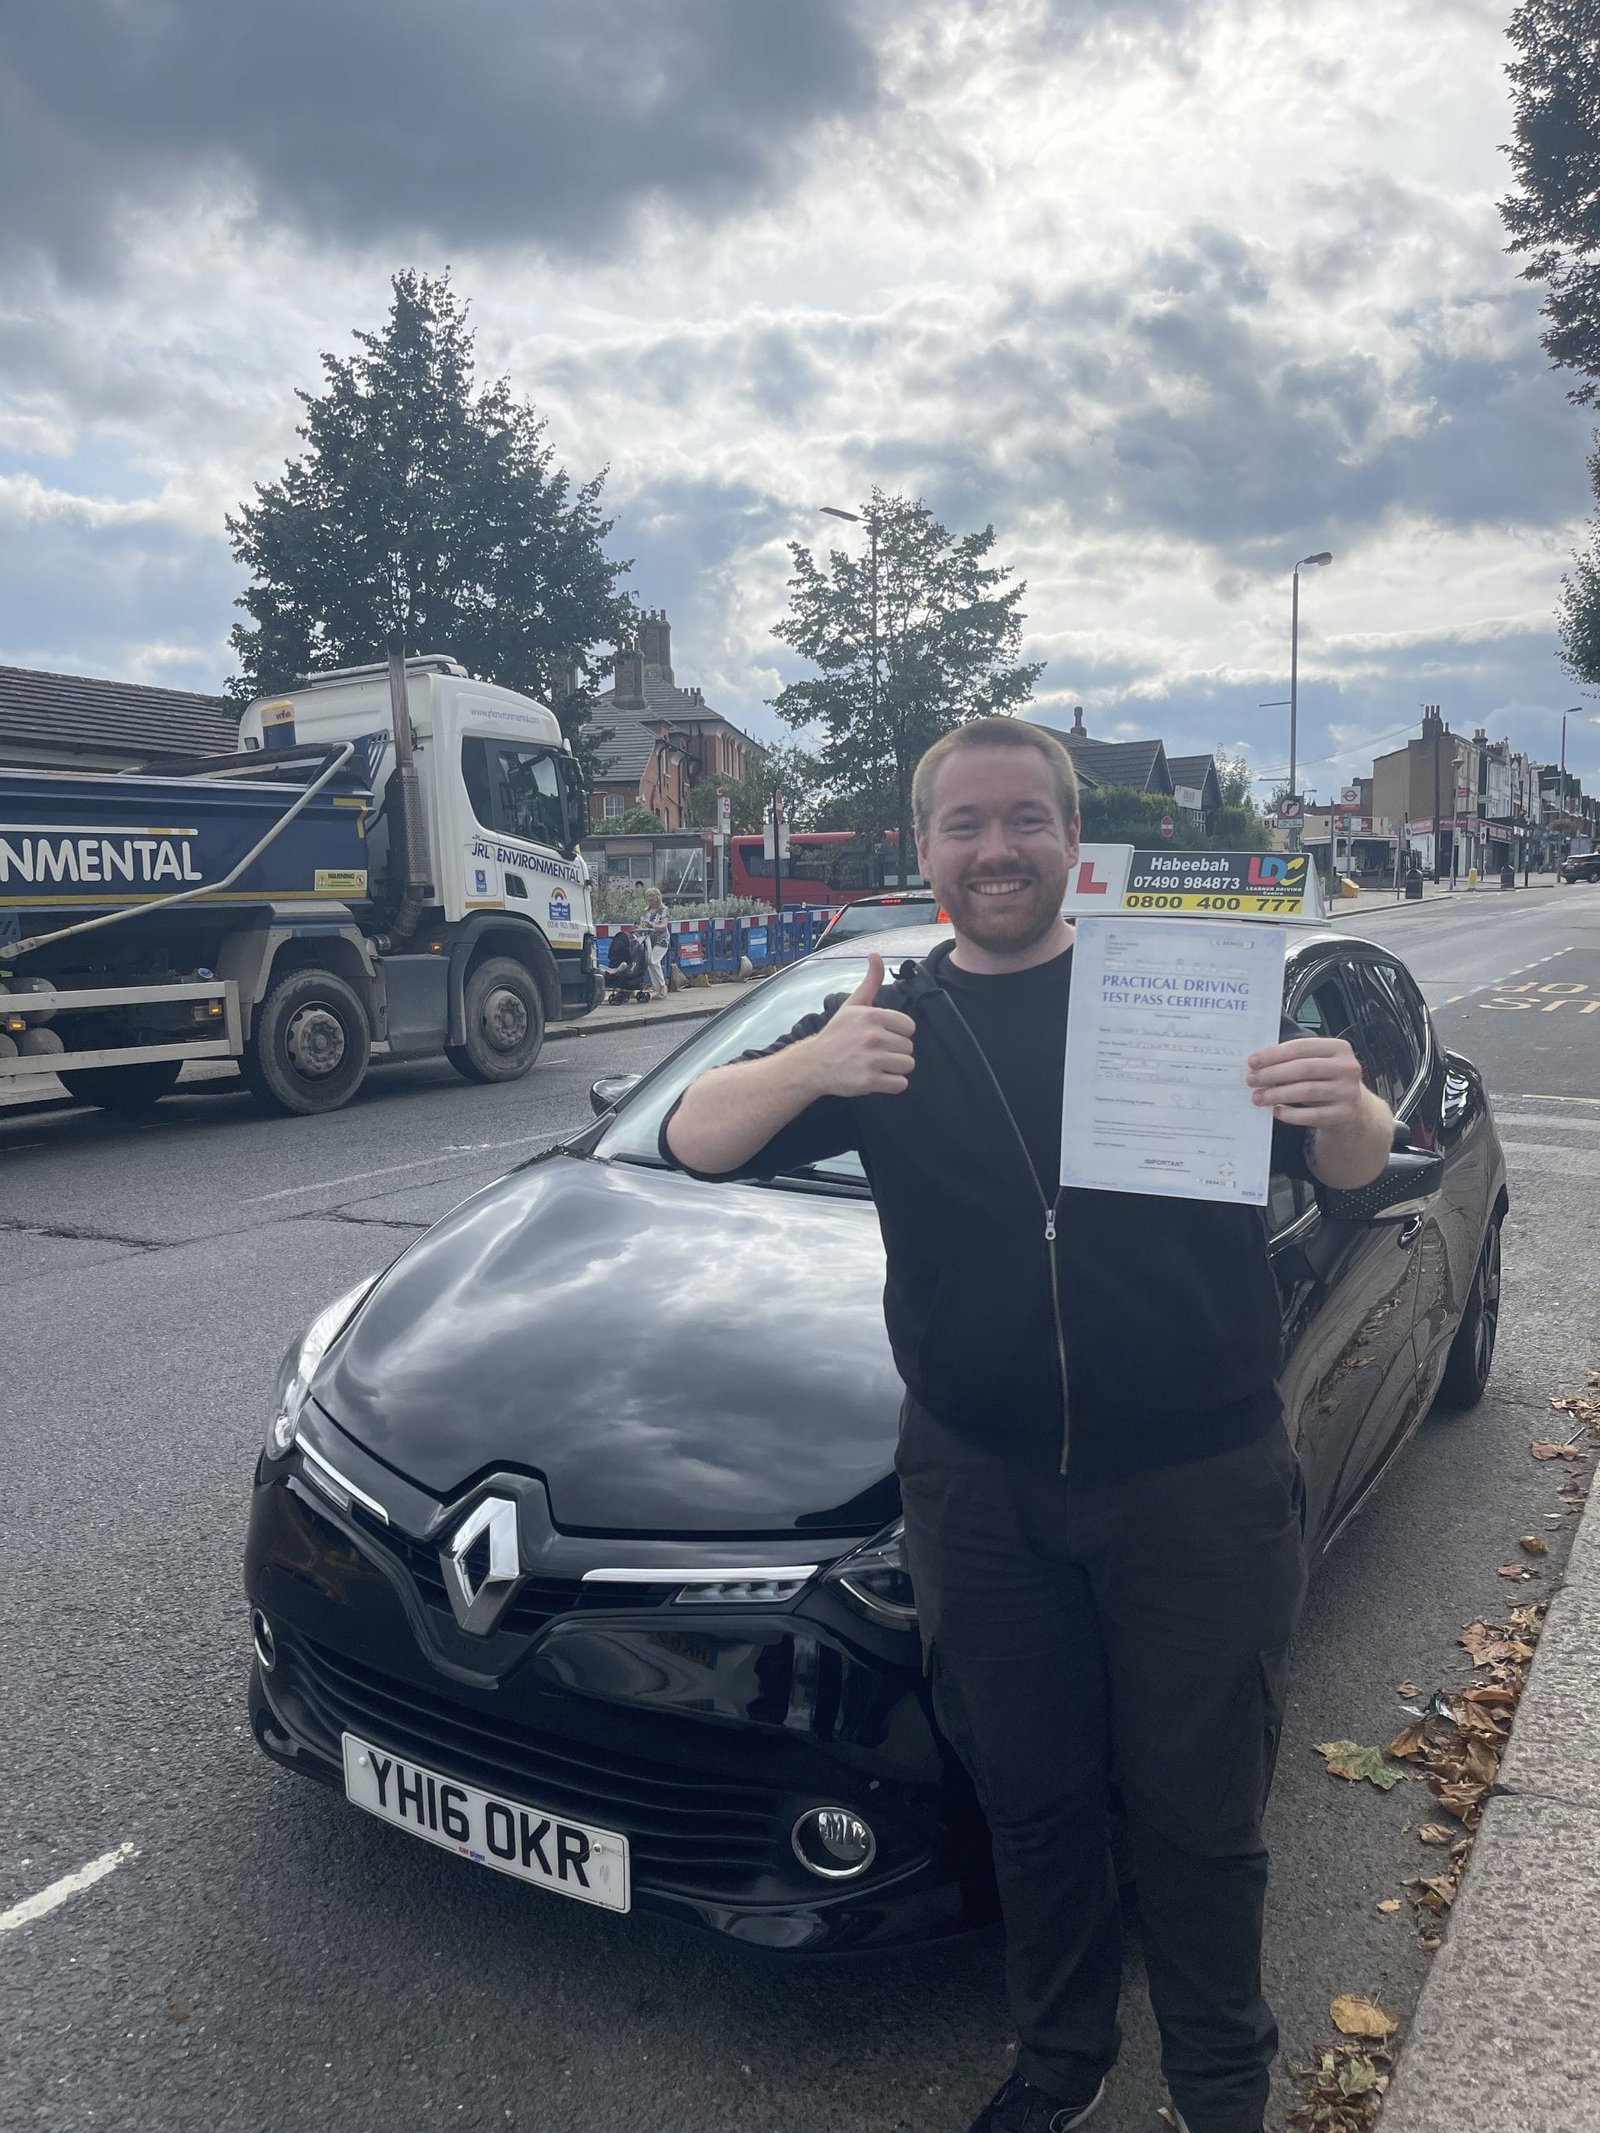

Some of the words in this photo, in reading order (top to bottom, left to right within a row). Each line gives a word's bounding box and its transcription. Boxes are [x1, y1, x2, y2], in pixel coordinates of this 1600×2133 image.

[0, 838, 202, 882] NMENTAL
[472, 842, 490, 859] JRL
[497, 848, 581, 883] ENVIRONMENTAL
[1150, 857, 1230, 872] Habeebah
[1075, 862, 1108, 894] L
[1133, 875, 1180, 889] 07490
[1183, 877, 1241, 890] 984873
[1126, 895, 1183, 909] 0800
[1196, 897, 1241, 911] 400
[1256, 898, 1301, 912] 777
[1102, 974, 1179, 991] PRACTICAL
[1184, 979, 1250, 995] DRIVING
[1490, 981, 1600, 996] OP
[1102, 991, 1130, 1003] TEST
[1133, 993, 1163, 1006] PASS
[1167, 995, 1248, 1011] CERTIFICATE
[1479, 997, 1600, 1014] US
[1144, 1158, 1184, 1168] IMPORTANT
[367, 1750, 471, 1842] YH16
[484, 1801, 591, 1888] OKR
